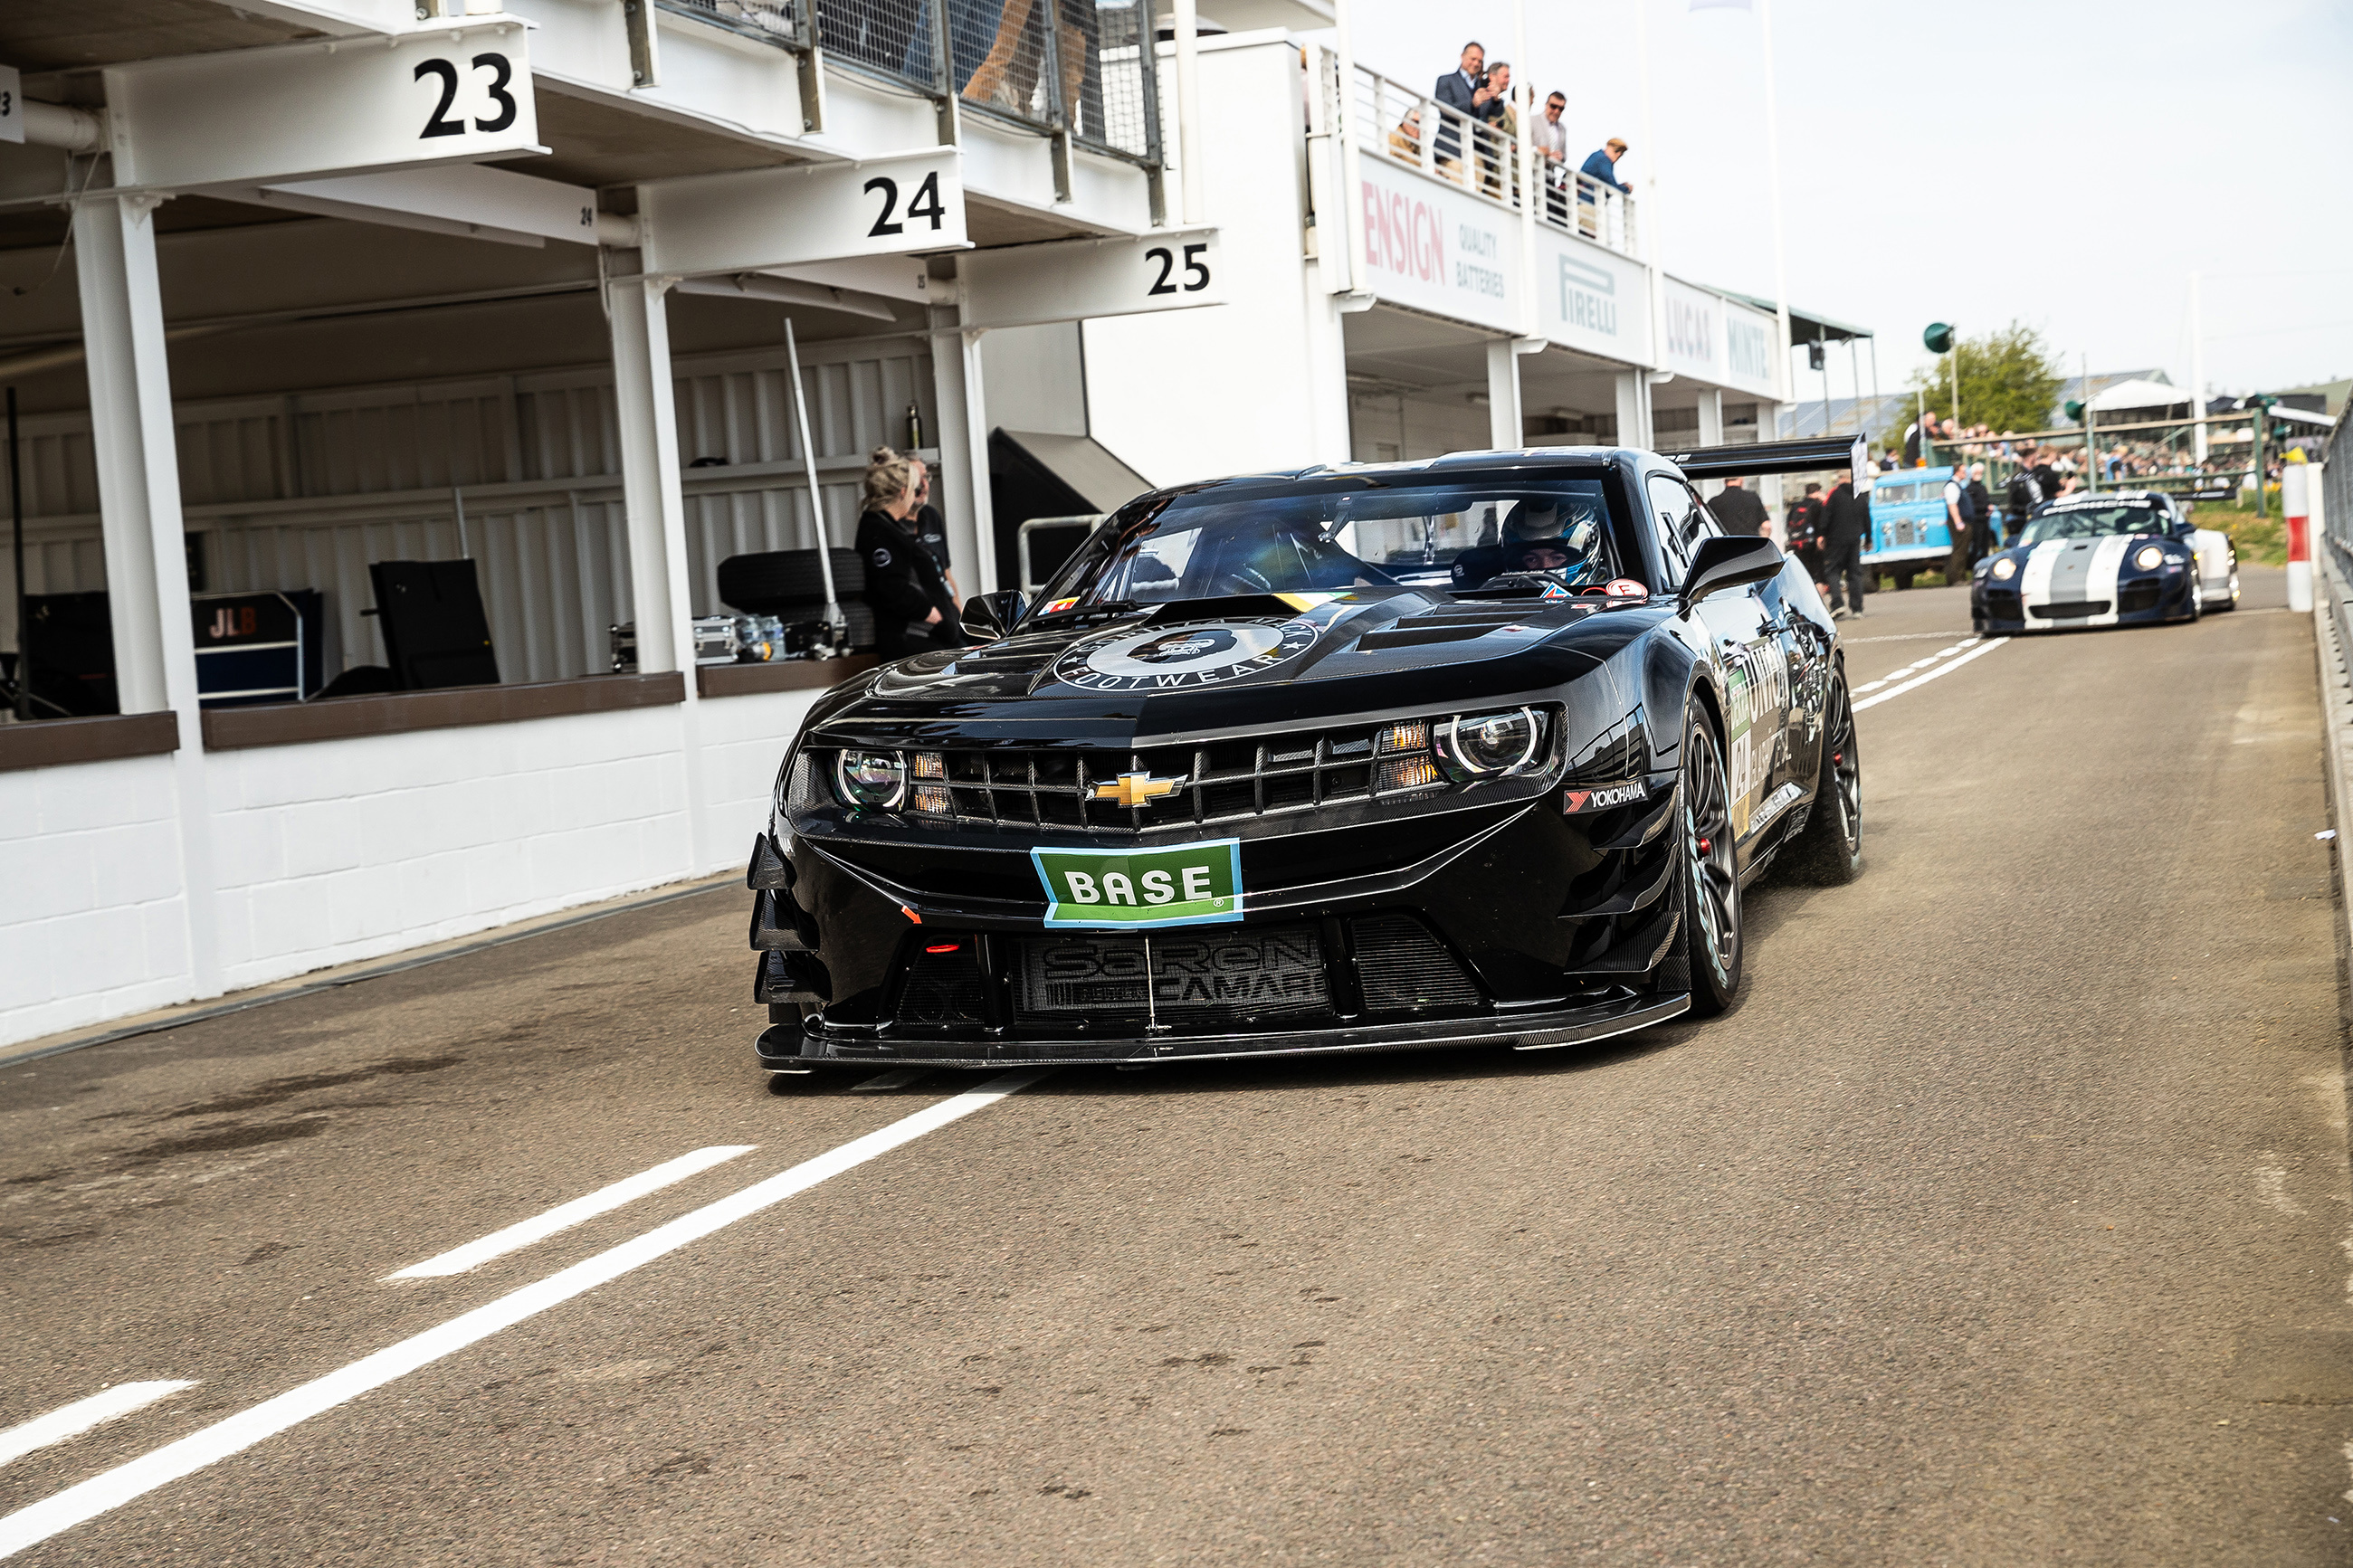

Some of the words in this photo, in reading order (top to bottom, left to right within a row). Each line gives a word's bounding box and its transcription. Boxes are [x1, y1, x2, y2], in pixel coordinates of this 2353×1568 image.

[0, 91, 11, 117] 3
[414, 52, 517, 139] 23
[863, 171, 945, 237] 24
[1362, 180, 1445, 288] ENSIGN
[1460, 223, 1496, 260] QUALITY
[1146, 243, 1210, 296] 25
[1456, 261, 1504, 299] BATTERIES
[1558, 252, 1616, 336] PIRELLI
[1665, 295, 1710, 362] LUCAS
[1726, 316, 1767, 379] MINTE
[209, 606, 257, 639] JLB
[1060, 653, 1284, 689] FOOTWEAR
[1590, 782, 1646, 808] YOKOHAMA
[1064, 865, 1212, 905] BASE
